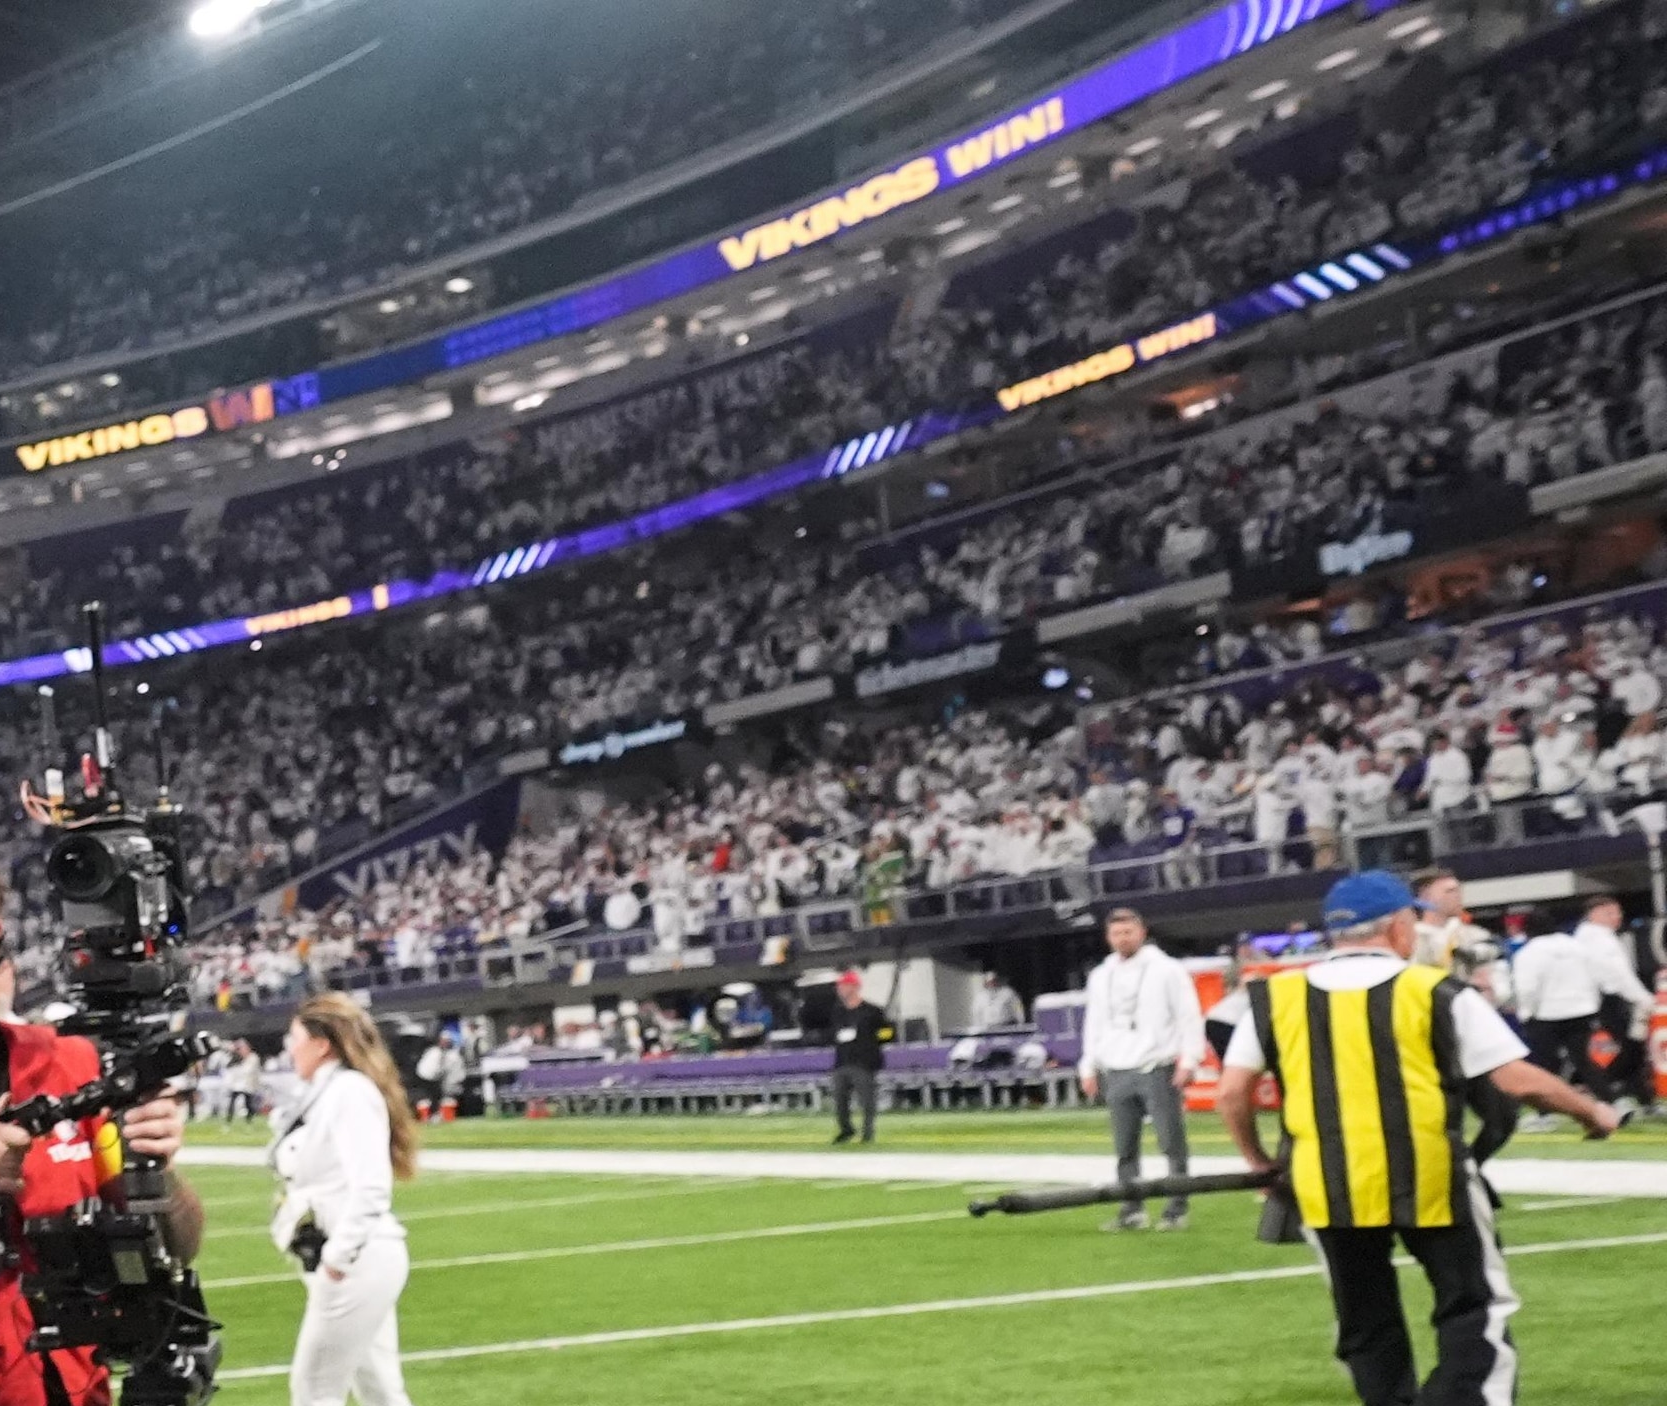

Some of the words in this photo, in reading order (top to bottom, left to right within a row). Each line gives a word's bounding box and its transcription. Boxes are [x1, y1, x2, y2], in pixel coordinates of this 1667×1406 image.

[719, 155, 941, 271] VIKINGS
[945, 96, 1065, 178] WIN!
[997, 343, 1136, 413] VIKINGS
[16, 405, 209, 472] VIKINGS
